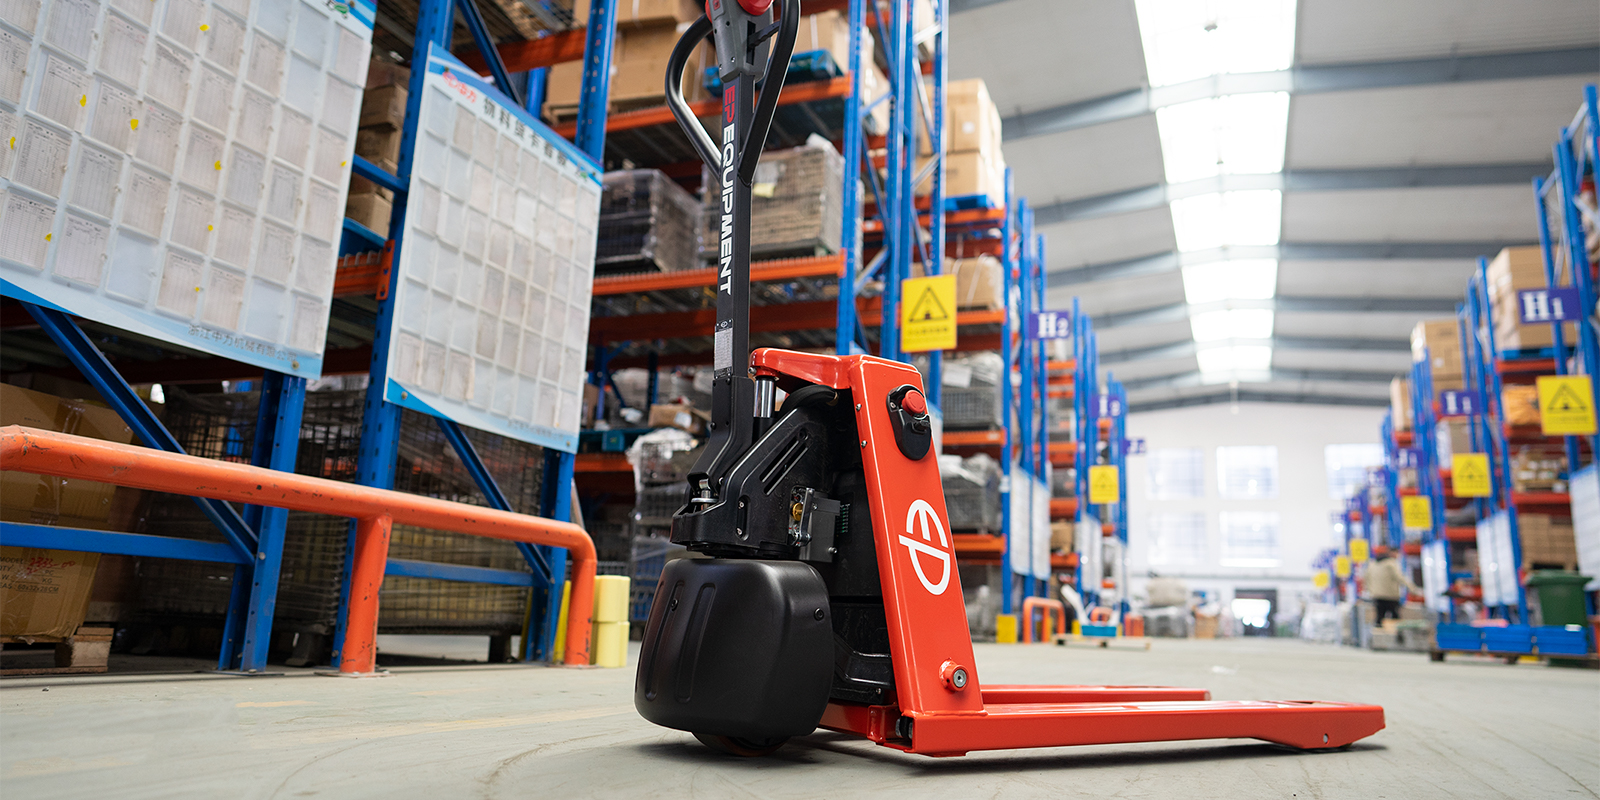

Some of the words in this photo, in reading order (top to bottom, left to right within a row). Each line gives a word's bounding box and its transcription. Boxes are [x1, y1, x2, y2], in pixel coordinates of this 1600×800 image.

[722, 86, 735, 123] EP
[717, 122, 735, 295] EQUIPMENT
[1523, 291, 1565, 322] H1
[1037, 312, 1069, 338] H2
